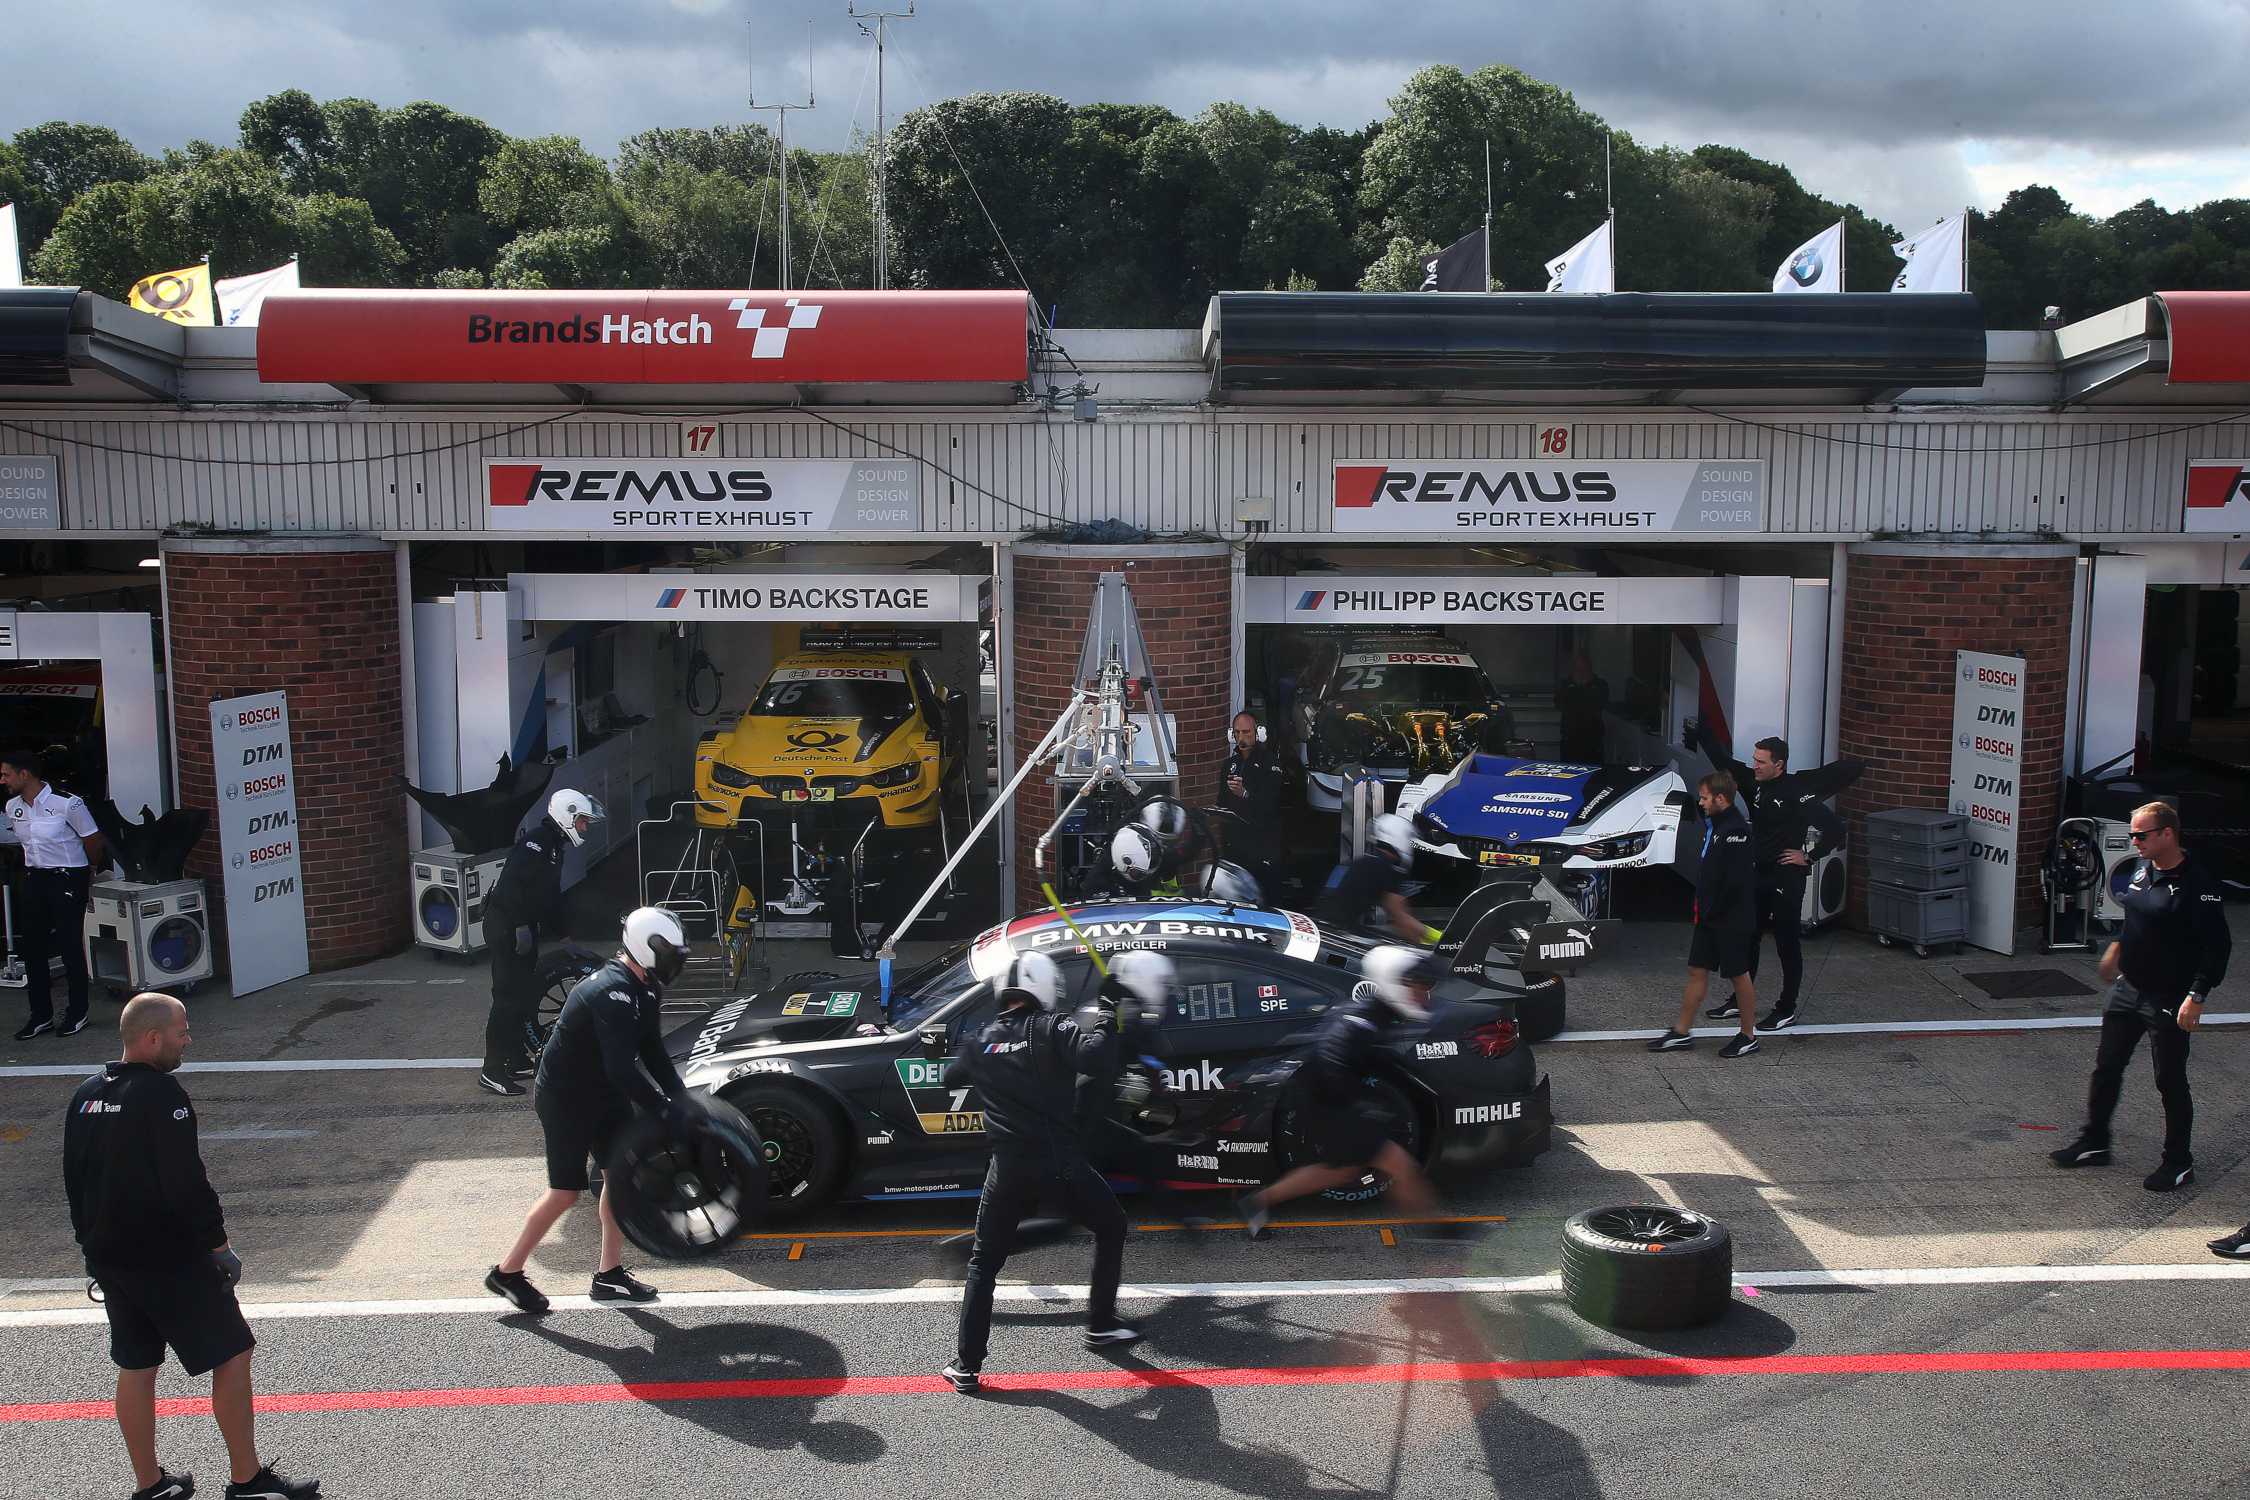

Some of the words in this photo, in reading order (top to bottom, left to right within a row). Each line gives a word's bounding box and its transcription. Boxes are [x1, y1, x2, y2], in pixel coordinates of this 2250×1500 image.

[686, 426, 716, 452] 17
[1539, 427, 1568, 454] 18
[0, 467, 46, 480] OUND
[856, 470, 908, 482] SOUND
[1702, 470, 1753, 482] SOUND
[523, 470, 773, 505] REMUS
[857, 490, 909, 502] DESIGN
[1371, 471, 1617, 506] REMUS
[1702, 490, 1753, 503] DESIGN
[0, 507, 49, 520] OWER
[612, 511, 813, 526] SPORTEXHAUST
[857, 510, 909, 521] POWER
[1456, 511, 1657, 527] SPORTEXHAUST
[1700, 510, 1752, 522] POWER
[694, 588, 762, 609] TIMO
[769, 588, 929, 610] BACKSTAGE
[1333, 590, 1437, 611] PHILIPP
[1443, 590, 1605, 612] BACKSTAGE
[1387, 654, 1461, 665] BOSCH
[815, 668, 888, 679] BOSCH
[1339, 666, 1387, 692] 25
[1978, 667, 2017, 687] BOSCH
[238, 706, 280, 726] BOSCH
[1977, 705, 2016, 727] DTM
[242, 742, 283, 766] DTM
[1975, 735, 2014, 757] BOSCH
[244, 773, 286, 795] BOSCH
[1973, 773, 2012, 796] DTM
[1504, 793, 1562, 802] SAMSUNG
[1480, 805, 1545, 817] SAMSUNG
[1546, 809, 1569, 820] SDI
[1971, 804, 2011, 826] BOSCH
[247, 810, 289, 835] DTM
[249, 841, 292, 864] BOSCH
[1969, 841, 2009, 866] DTM
[254, 876, 294, 903] DTM
[1031, 921, 1149, 947] BMW
[1159, 921, 1271, 943] Bank
[1095, 940, 1168, 952] SPENGLER
[1539, 941, 1585, 960] PUMA
[1453, 965, 1479, 974] amplus
[1260, 999, 1288, 1012] SPE
[685, 1021, 738, 1077] Bank
[1009, 1040, 1028, 1052] Team
[1159, 1060, 1225, 1092] ank
[103, 1102, 122, 1113] Team
[949, 1088, 969, 1112] 7
[943, 1113, 984, 1132] ADA
[1455, 1101, 1521, 1125] MAHLE
[867, 1136, 890, 1145] PUMA
[884, 1182, 960, 1194] bmw-motorsport.com
[1218, 1176, 1261, 1185] bmw-m.com
